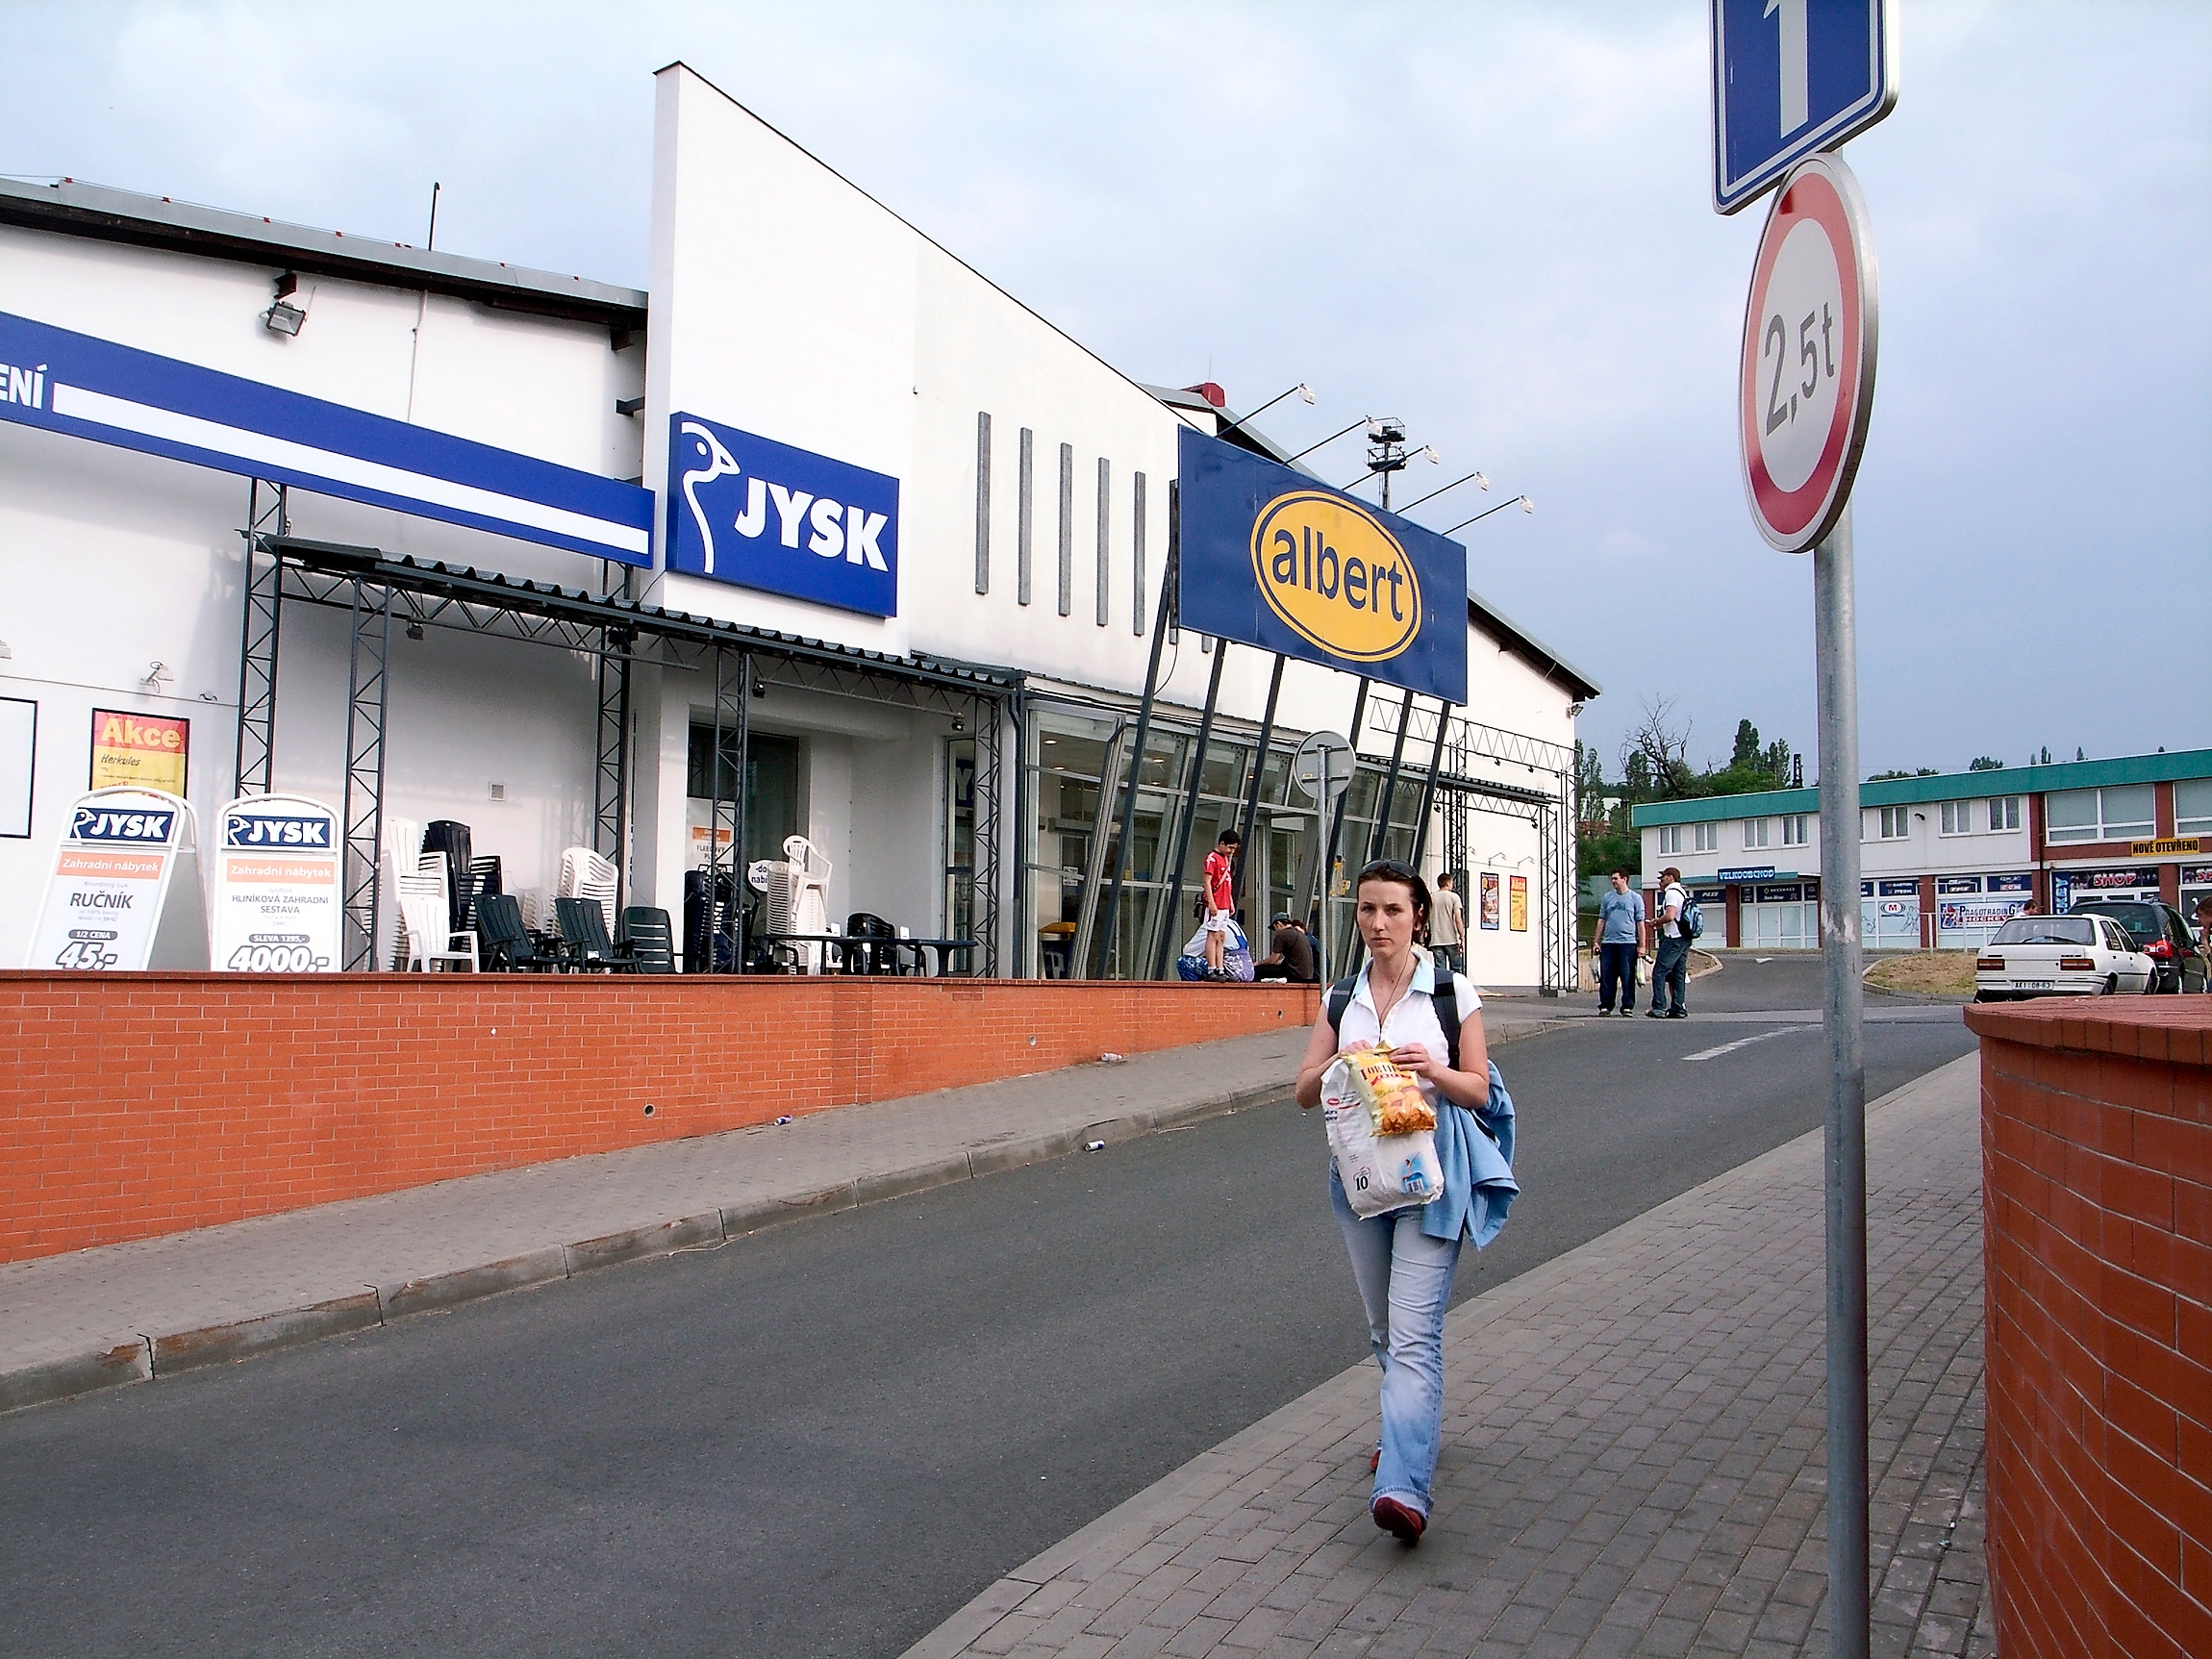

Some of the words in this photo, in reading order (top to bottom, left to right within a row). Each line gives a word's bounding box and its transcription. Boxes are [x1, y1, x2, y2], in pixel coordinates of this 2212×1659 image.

[1764, 301, 1835, 437] 2,5t
[734, 476, 890, 572] JYSK
[1271, 525, 1403, 622] albert
[101, 717, 181, 748] Akce
[100, 754, 141, 767] Herkules
[89, 813, 168, 839] JYSK
[247, 819, 326, 844] JYSK
[2155, 840, 2199, 853] OTEVŘENO
[63, 858, 113, 869] Zahradní
[114, 861, 160, 873] nábytek
[231, 865, 282, 875] Zahradní
[285, 867, 331, 878] nábytek
[1719, 868, 1774, 880] VELKOOBCHOD
[2094, 872, 2137, 887] SHOP
[69, 891, 135, 909] RUČNÍK
[232, 893, 281, 903] HLINÍKOVÁ
[283, 895, 329, 904] ZAHRADNÍ
[261, 905, 300, 914] SESTAVA
[1356, 1175, 1369, 1191] 10
